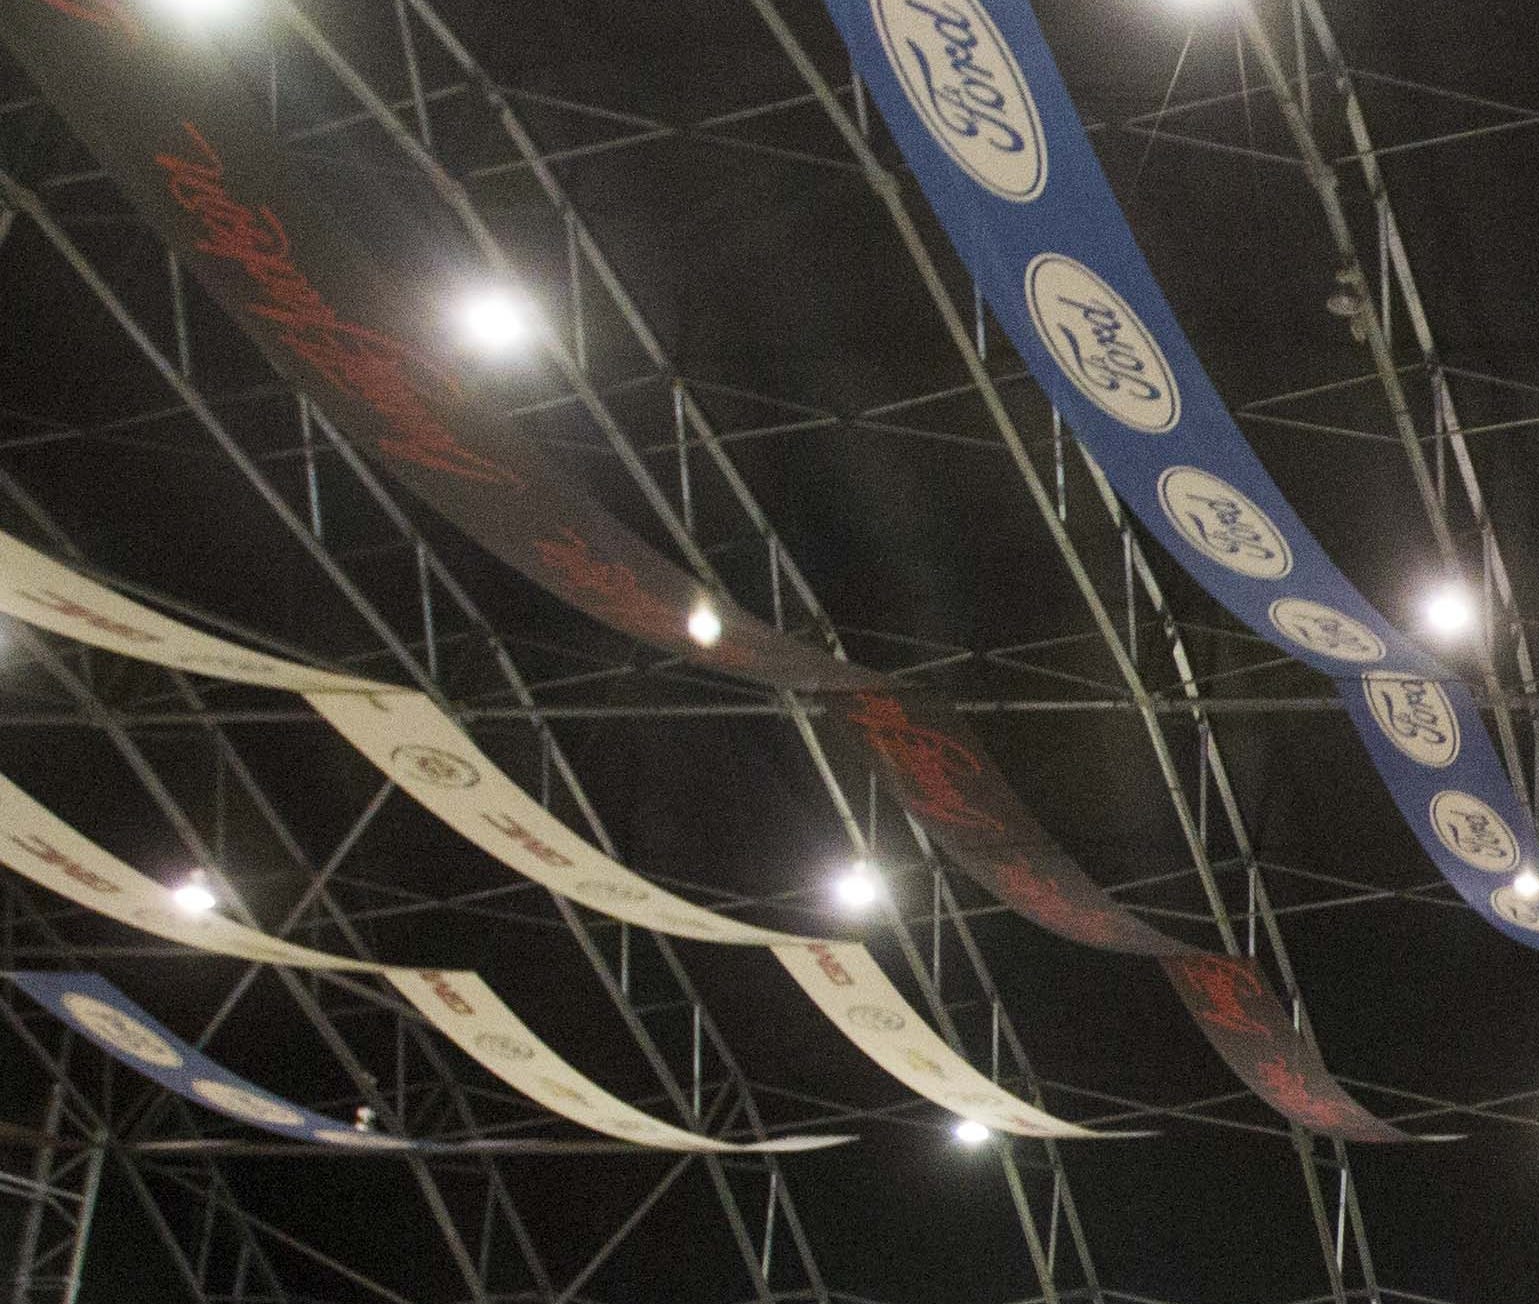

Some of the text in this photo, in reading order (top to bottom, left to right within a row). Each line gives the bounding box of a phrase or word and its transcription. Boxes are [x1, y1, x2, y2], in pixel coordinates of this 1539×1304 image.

[903, 0, 1022, 153] Ford
[1057, 296, 1160, 401] Ford
[1186, 494, 1276, 561] Ford
[806, 942, 853, 986] GM
